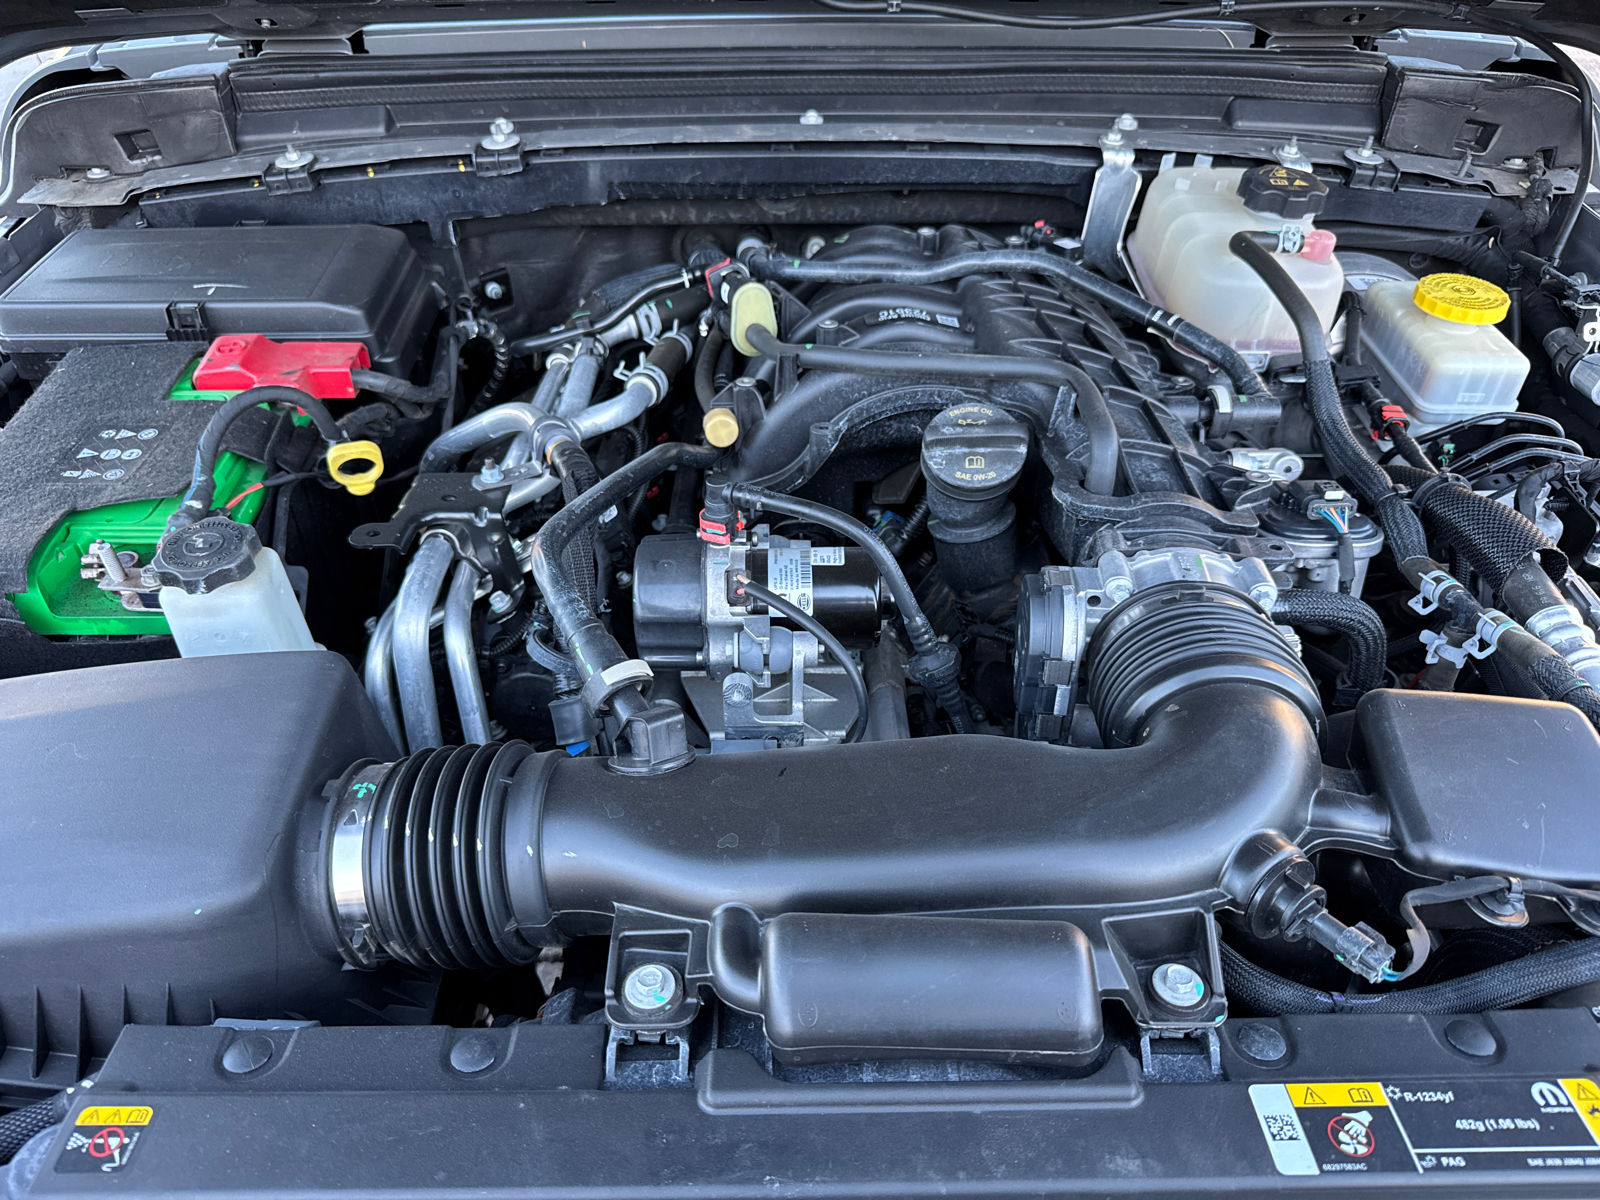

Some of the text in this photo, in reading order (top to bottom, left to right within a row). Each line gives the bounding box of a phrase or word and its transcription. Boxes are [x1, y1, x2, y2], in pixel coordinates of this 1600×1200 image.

[949, 407, 994, 417] ENGINE OIL
[954, 470, 997, 481] SAE 0W-20
[1403, 1090, 1455, 1104] R-1234yf
[1440, 1156, 1467, 1168] PAG
